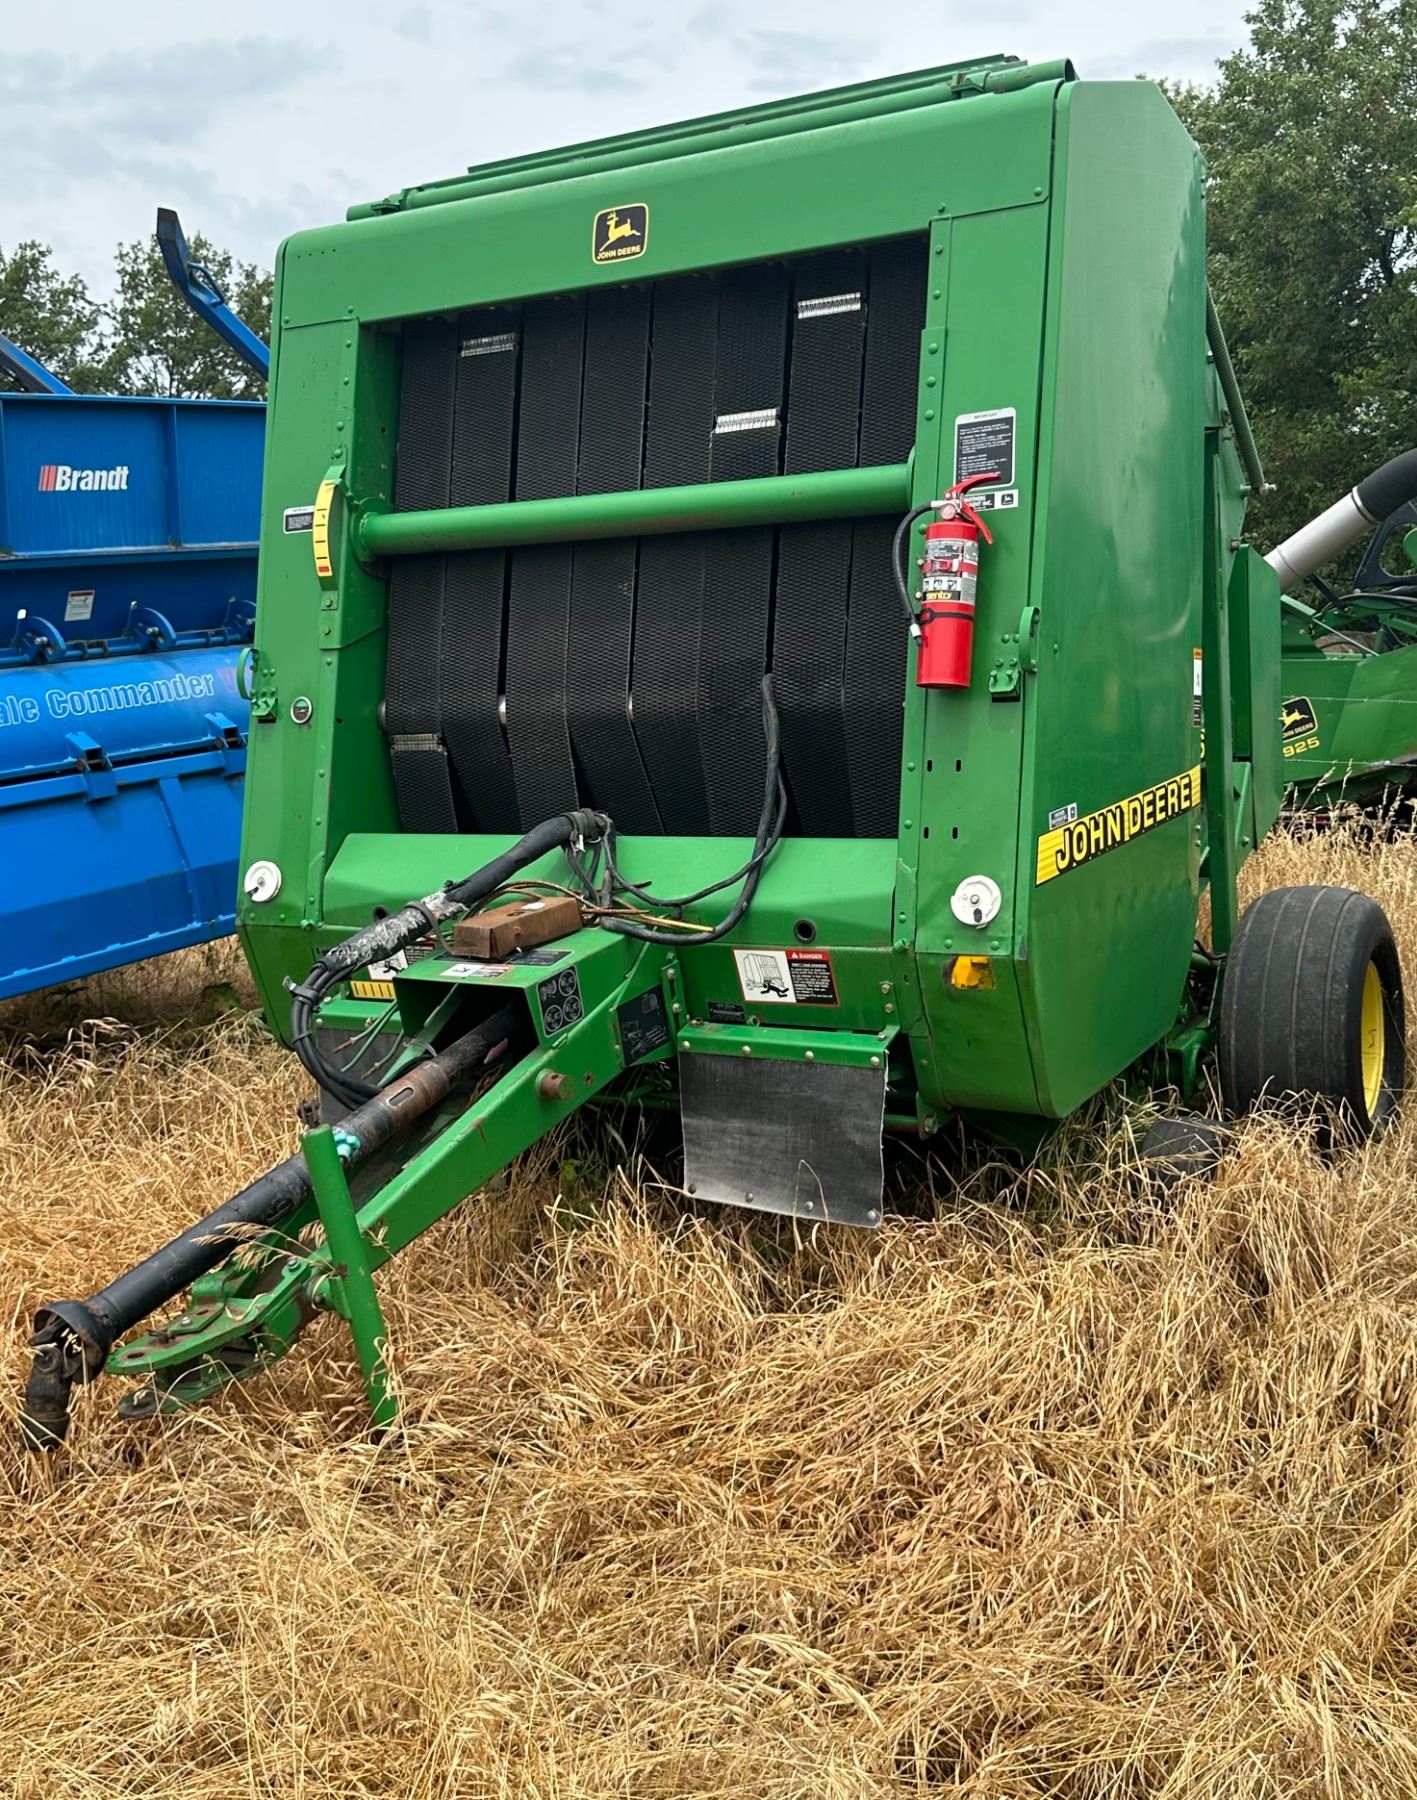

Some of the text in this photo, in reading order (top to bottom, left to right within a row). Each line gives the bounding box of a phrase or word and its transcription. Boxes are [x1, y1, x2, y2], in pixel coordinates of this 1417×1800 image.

[597, 245, 641, 260] JOHN DEERE
[55, 465, 130, 491] Brandt
[46, 674, 213, 718] Commander
[1282, 736, 1320, 758] 925
[1056, 774, 1192, 871] JOHN DEERE
